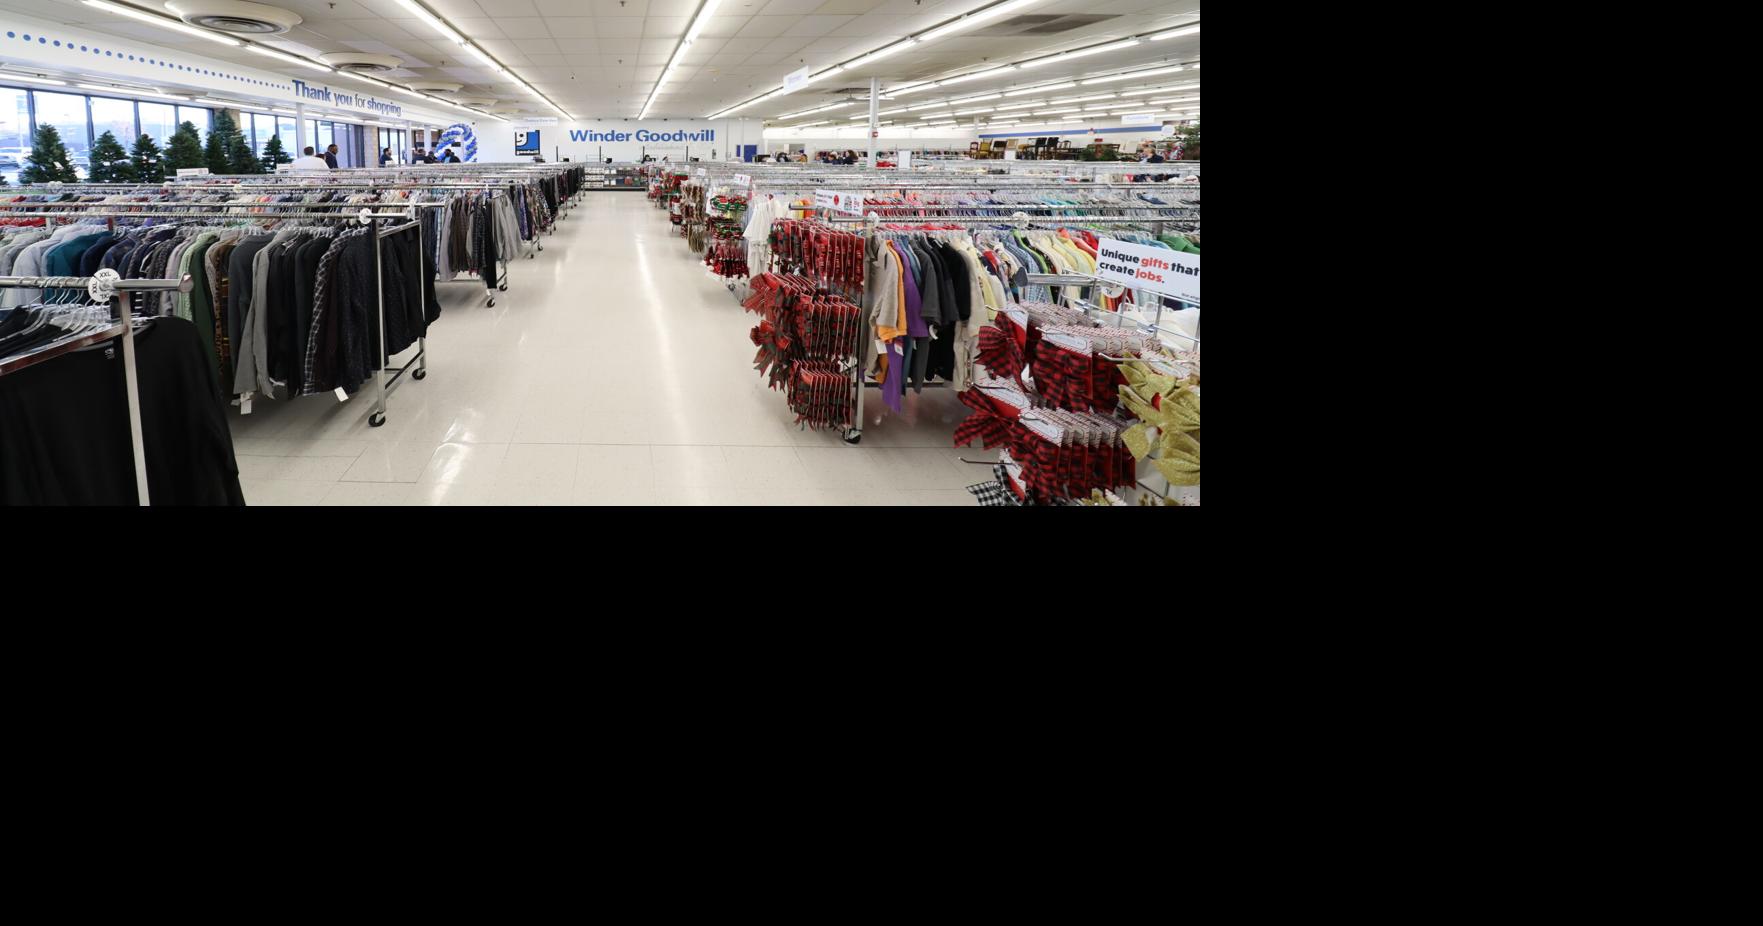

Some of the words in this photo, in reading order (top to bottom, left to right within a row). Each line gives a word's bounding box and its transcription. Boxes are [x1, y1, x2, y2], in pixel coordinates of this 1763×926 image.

[292, 80, 331, 102] Thank
[334, 92, 353, 107] you
[355, 94, 365, 107] for
[367, 97, 402, 117] shopping
[569, 129, 632, 142] Winder
[636, 129, 715, 142] Goodwill
[1099, 262, 1135, 276] create
[1135, 268, 1165, 284] jobs.
[1101, 248, 1140, 263] Unique
[1141, 257, 1169, 271] gifts
[1171, 262, 1200, 277] that
